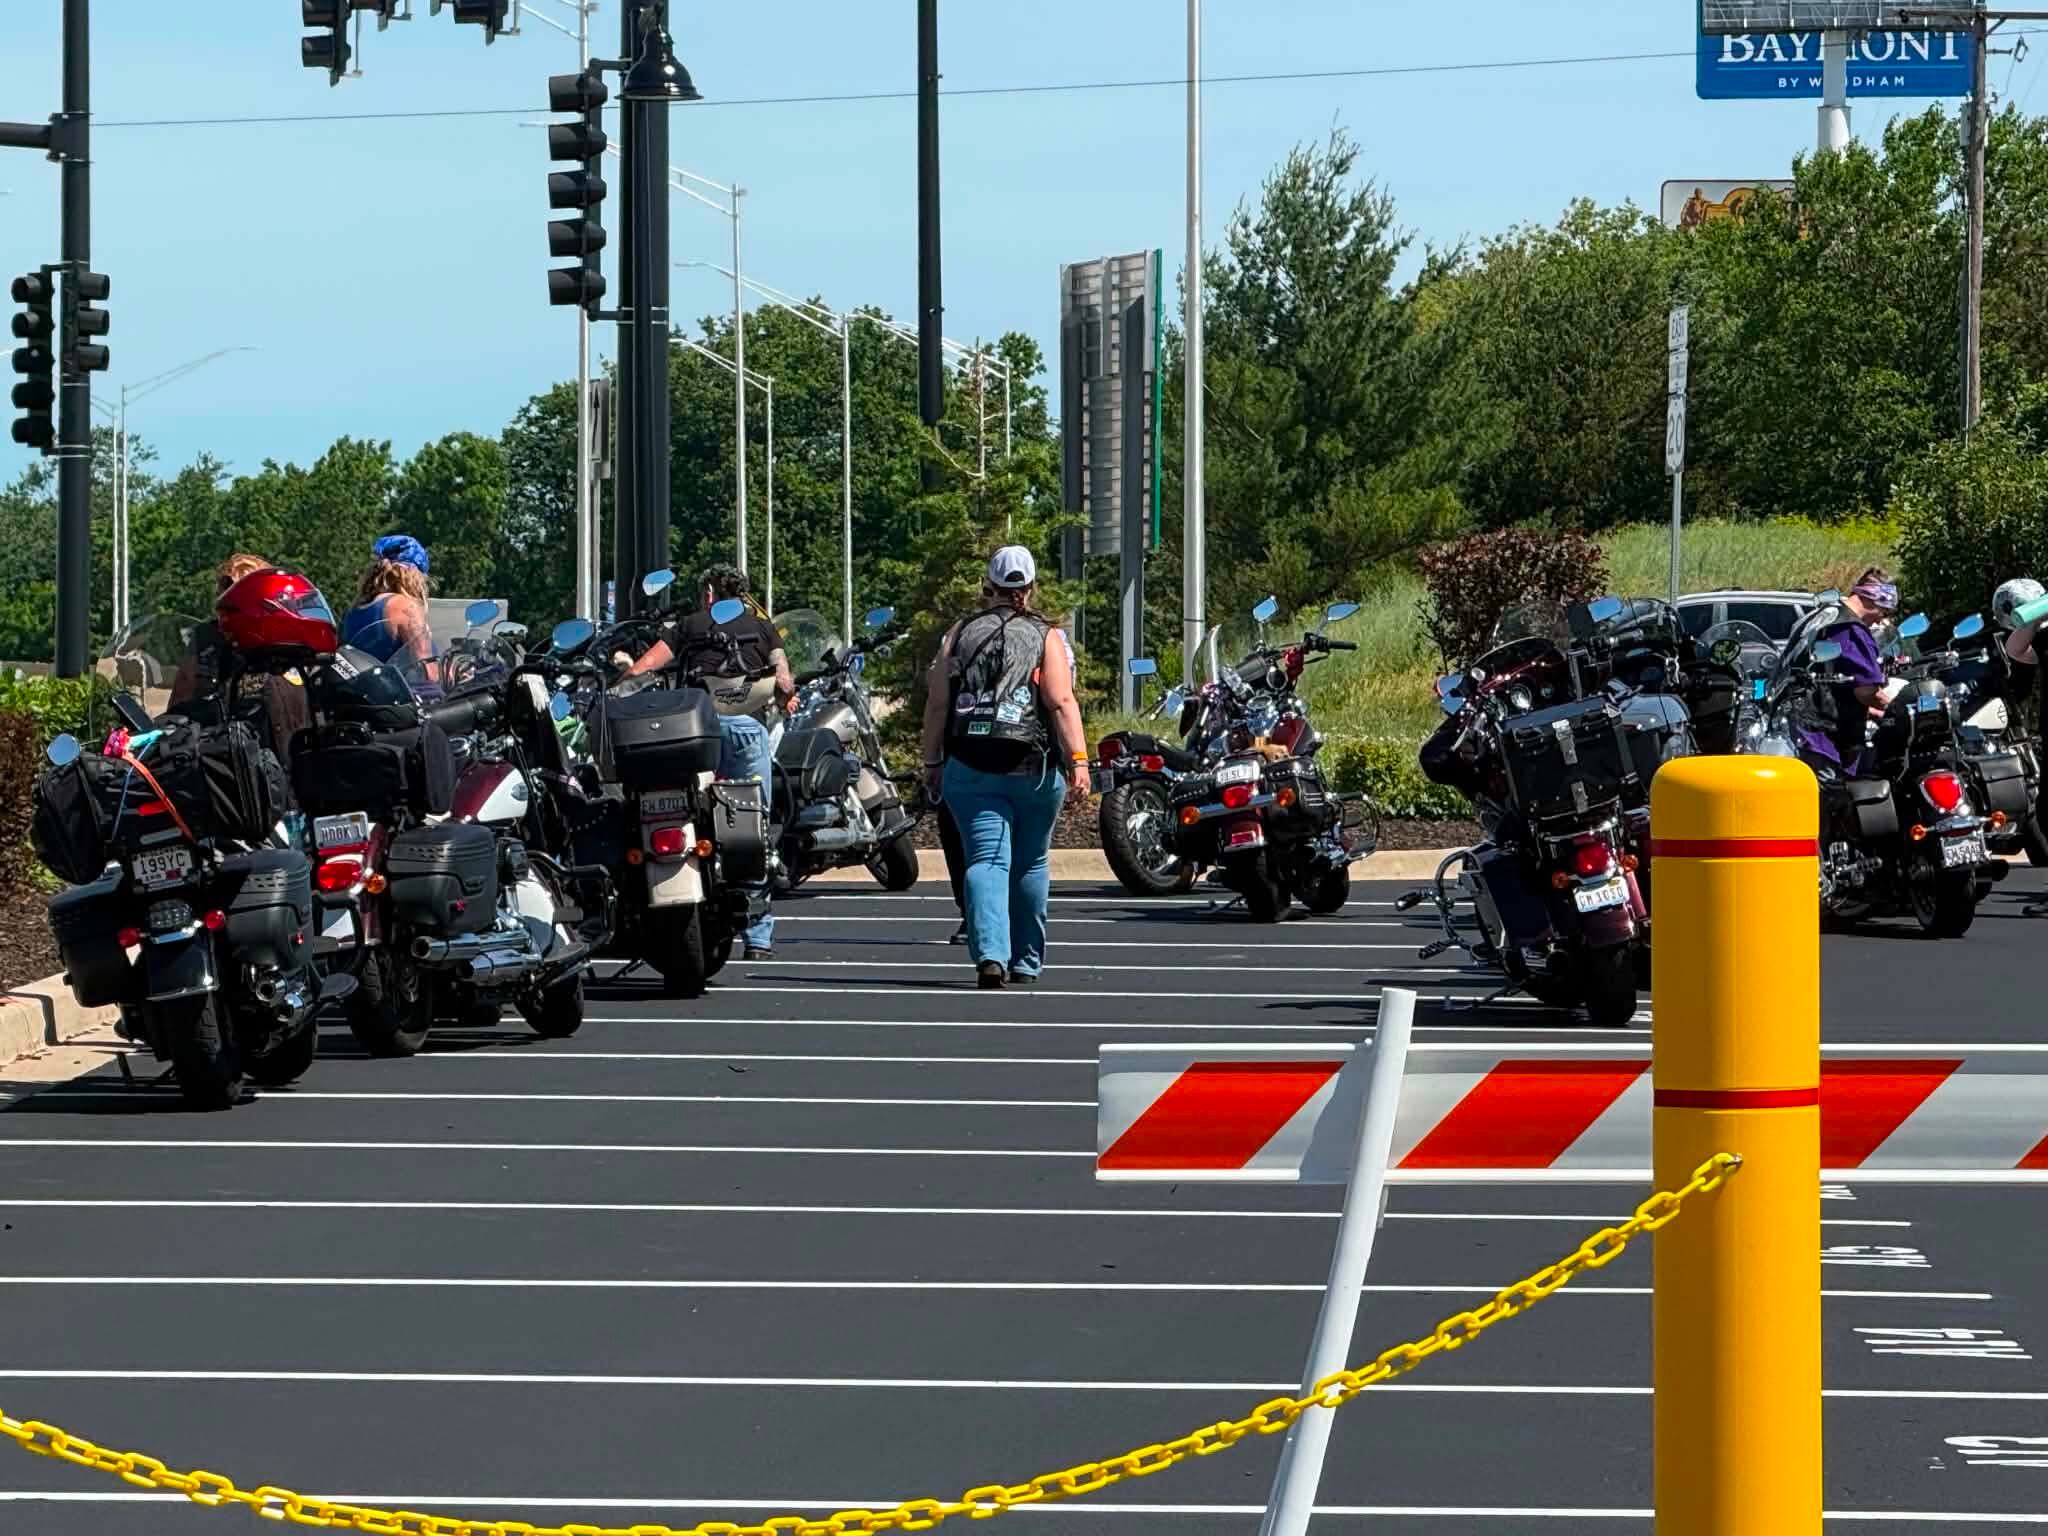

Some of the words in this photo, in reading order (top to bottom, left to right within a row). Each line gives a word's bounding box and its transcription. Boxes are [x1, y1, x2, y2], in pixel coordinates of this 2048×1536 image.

[1778, 76, 1799, 88] BY
[1808, 75, 1905, 88] WDHAM
[1667, 411, 1683, 456] 20
